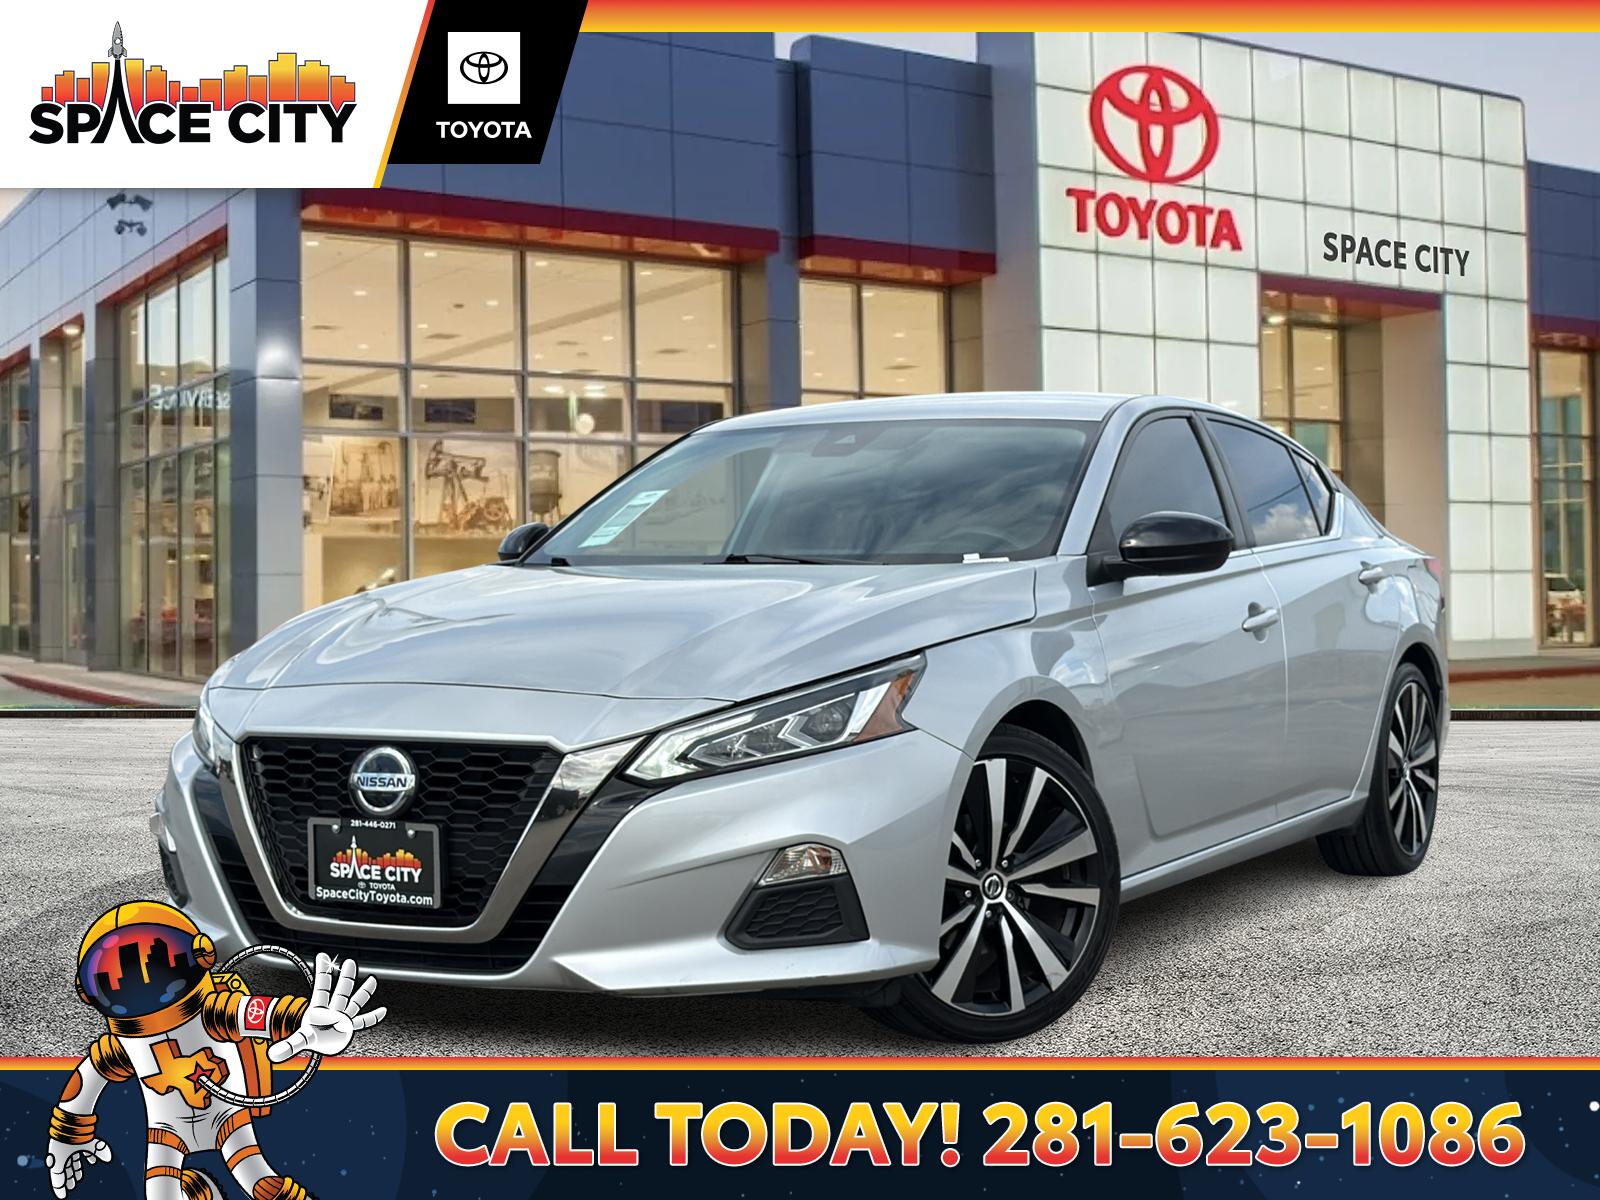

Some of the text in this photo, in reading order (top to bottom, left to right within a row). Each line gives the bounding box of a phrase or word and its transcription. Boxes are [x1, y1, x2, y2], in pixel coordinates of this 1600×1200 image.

[1065, 187, 1242, 251] TOYOTA
[1323, 232, 1470, 277] SPACE CITY
[356, 776, 407, 788] NISSAN
[330, 848, 422, 883] SPACE CITY
[316, 887, 433, 906] SpaceCityToyota.com
[369, 882, 396, 891] TOYOTA
